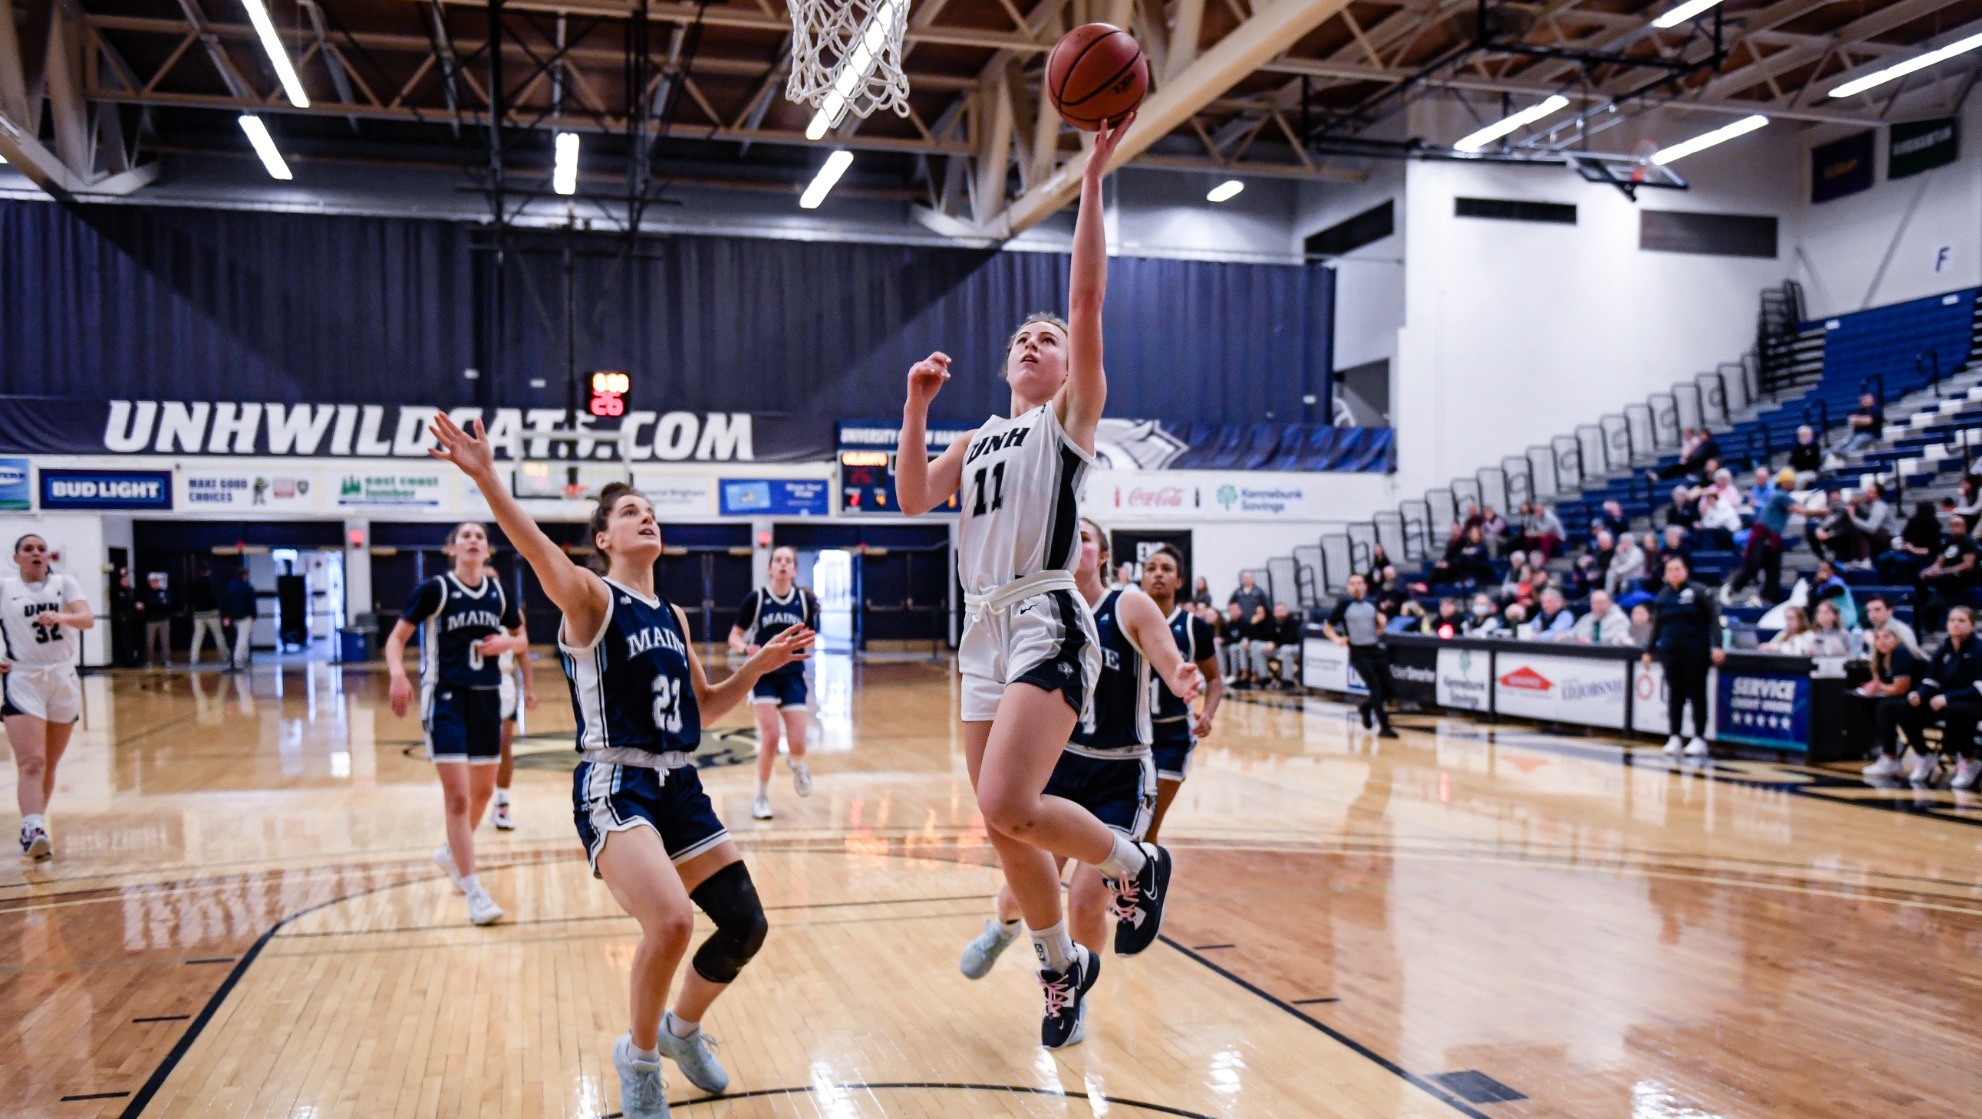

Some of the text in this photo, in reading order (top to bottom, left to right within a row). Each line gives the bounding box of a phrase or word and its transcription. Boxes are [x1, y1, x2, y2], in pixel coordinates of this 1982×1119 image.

[1935, 246, 1950, 272] F
[840, 427, 898, 444] UNIVERSITY
[966, 427, 1031, 465] UNH
[52, 481, 160, 499] BUD LIGHT
[973, 460, 1006, 518] 11
[1241, 501, 1285, 513] Savings
[447, 610, 501, 631] MAIN
[626, 626, 688, 668] MAIN
[1732, 676, 1797, 700] SERVICE
[651, 673, 683, 734] 23
